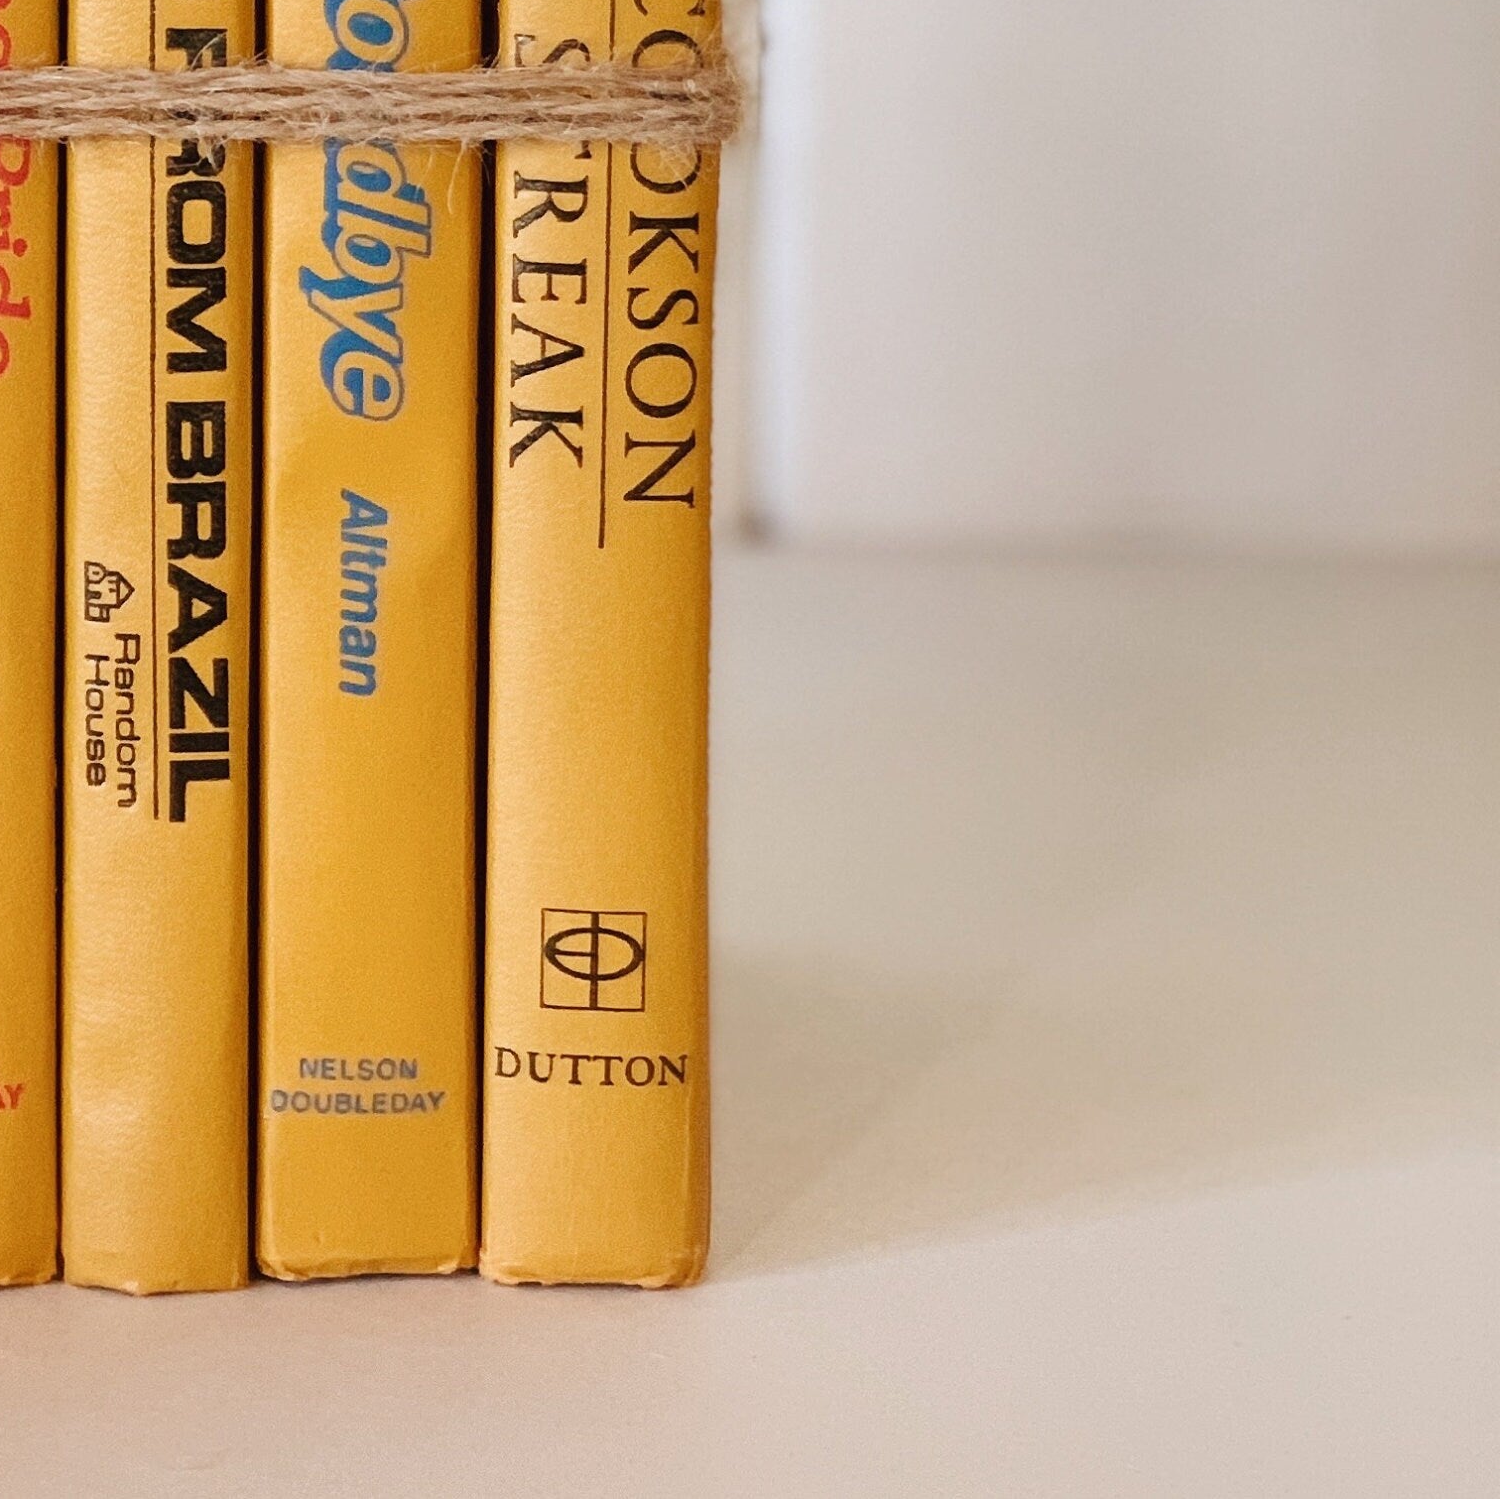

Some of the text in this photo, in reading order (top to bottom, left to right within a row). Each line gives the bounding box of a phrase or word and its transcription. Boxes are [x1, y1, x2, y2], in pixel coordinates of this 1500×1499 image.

[509, 33, 591, 470] SREAK
[165, 400, 232, 823] BRAZIL
[338, 488, 390, 698] Altman
[84, 653, 110, 787] House
[114, 632, 141, 809] Random
[270, 1089, 446, 1116] DOUBLEDAY
[299, 1057, 419, 1082] NELSON
[494, 1046, 688, 1086] DUTTON
